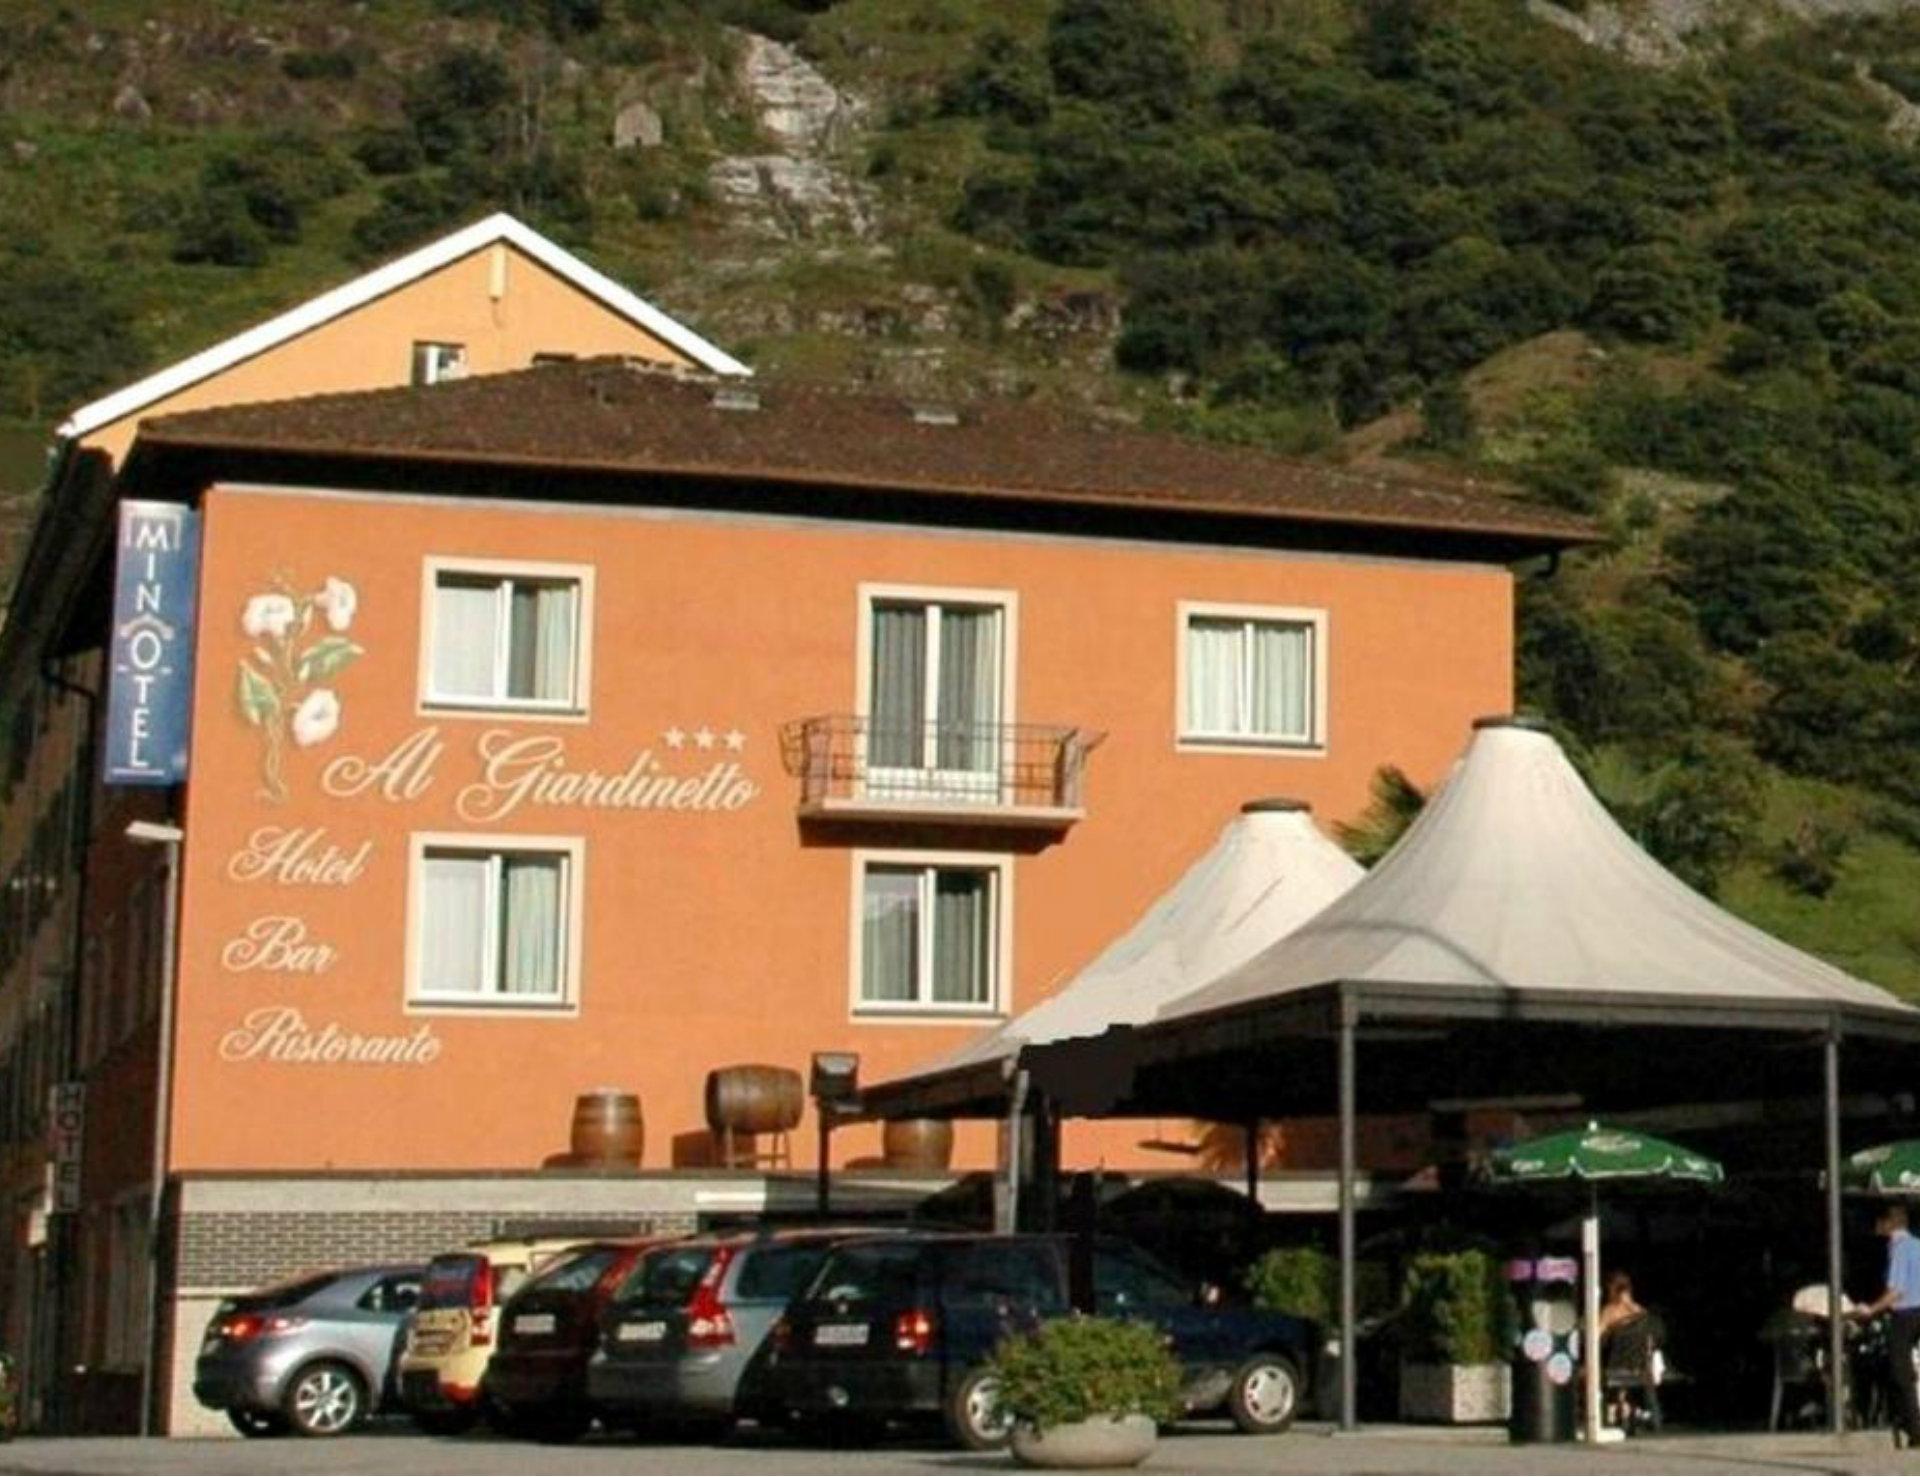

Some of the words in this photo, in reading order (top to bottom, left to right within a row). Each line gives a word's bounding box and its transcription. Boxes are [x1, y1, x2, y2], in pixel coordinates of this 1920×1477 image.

[129, 522, 169, 768] MINOTEL
[322, 726, 444, 801] Al
[457, 729, 761, 822] Giardinetto
[228, 826, 373, 884] Hotel
[222, 917, 335, 973] Bar
[219, 1006, 443, 1063] Ristorante
[57, 1083, 83, 1209] HOTEL
